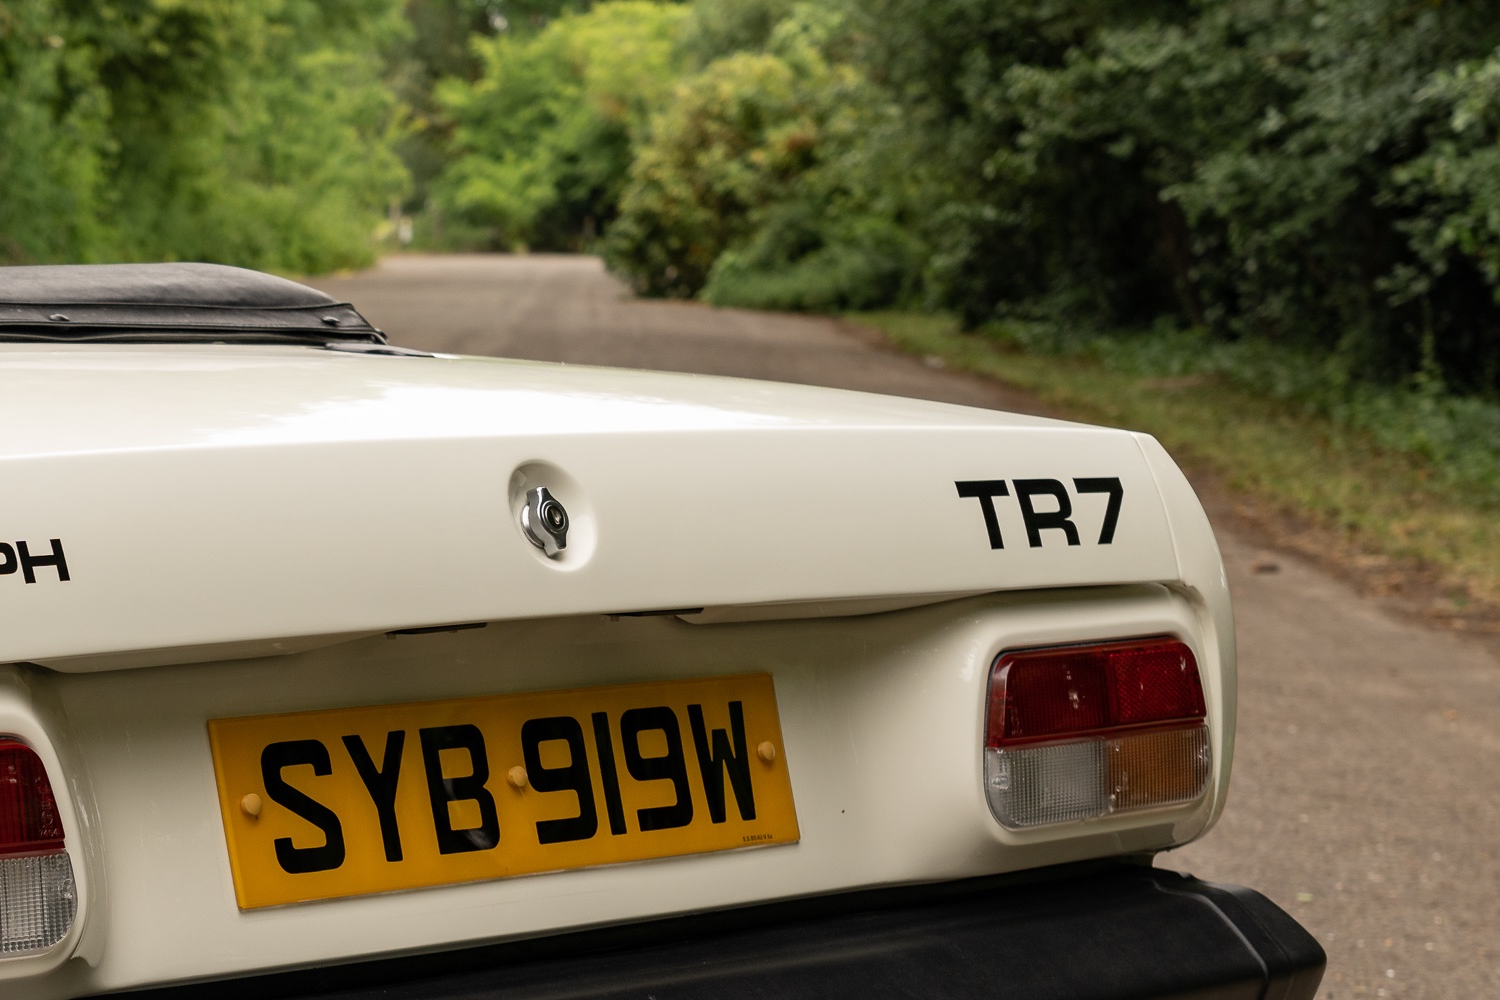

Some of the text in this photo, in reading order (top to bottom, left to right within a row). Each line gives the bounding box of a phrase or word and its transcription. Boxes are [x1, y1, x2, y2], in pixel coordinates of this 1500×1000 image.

[954, 477, 1124, 550] TR7
[260, 700, 758, 874] SYB 919W
